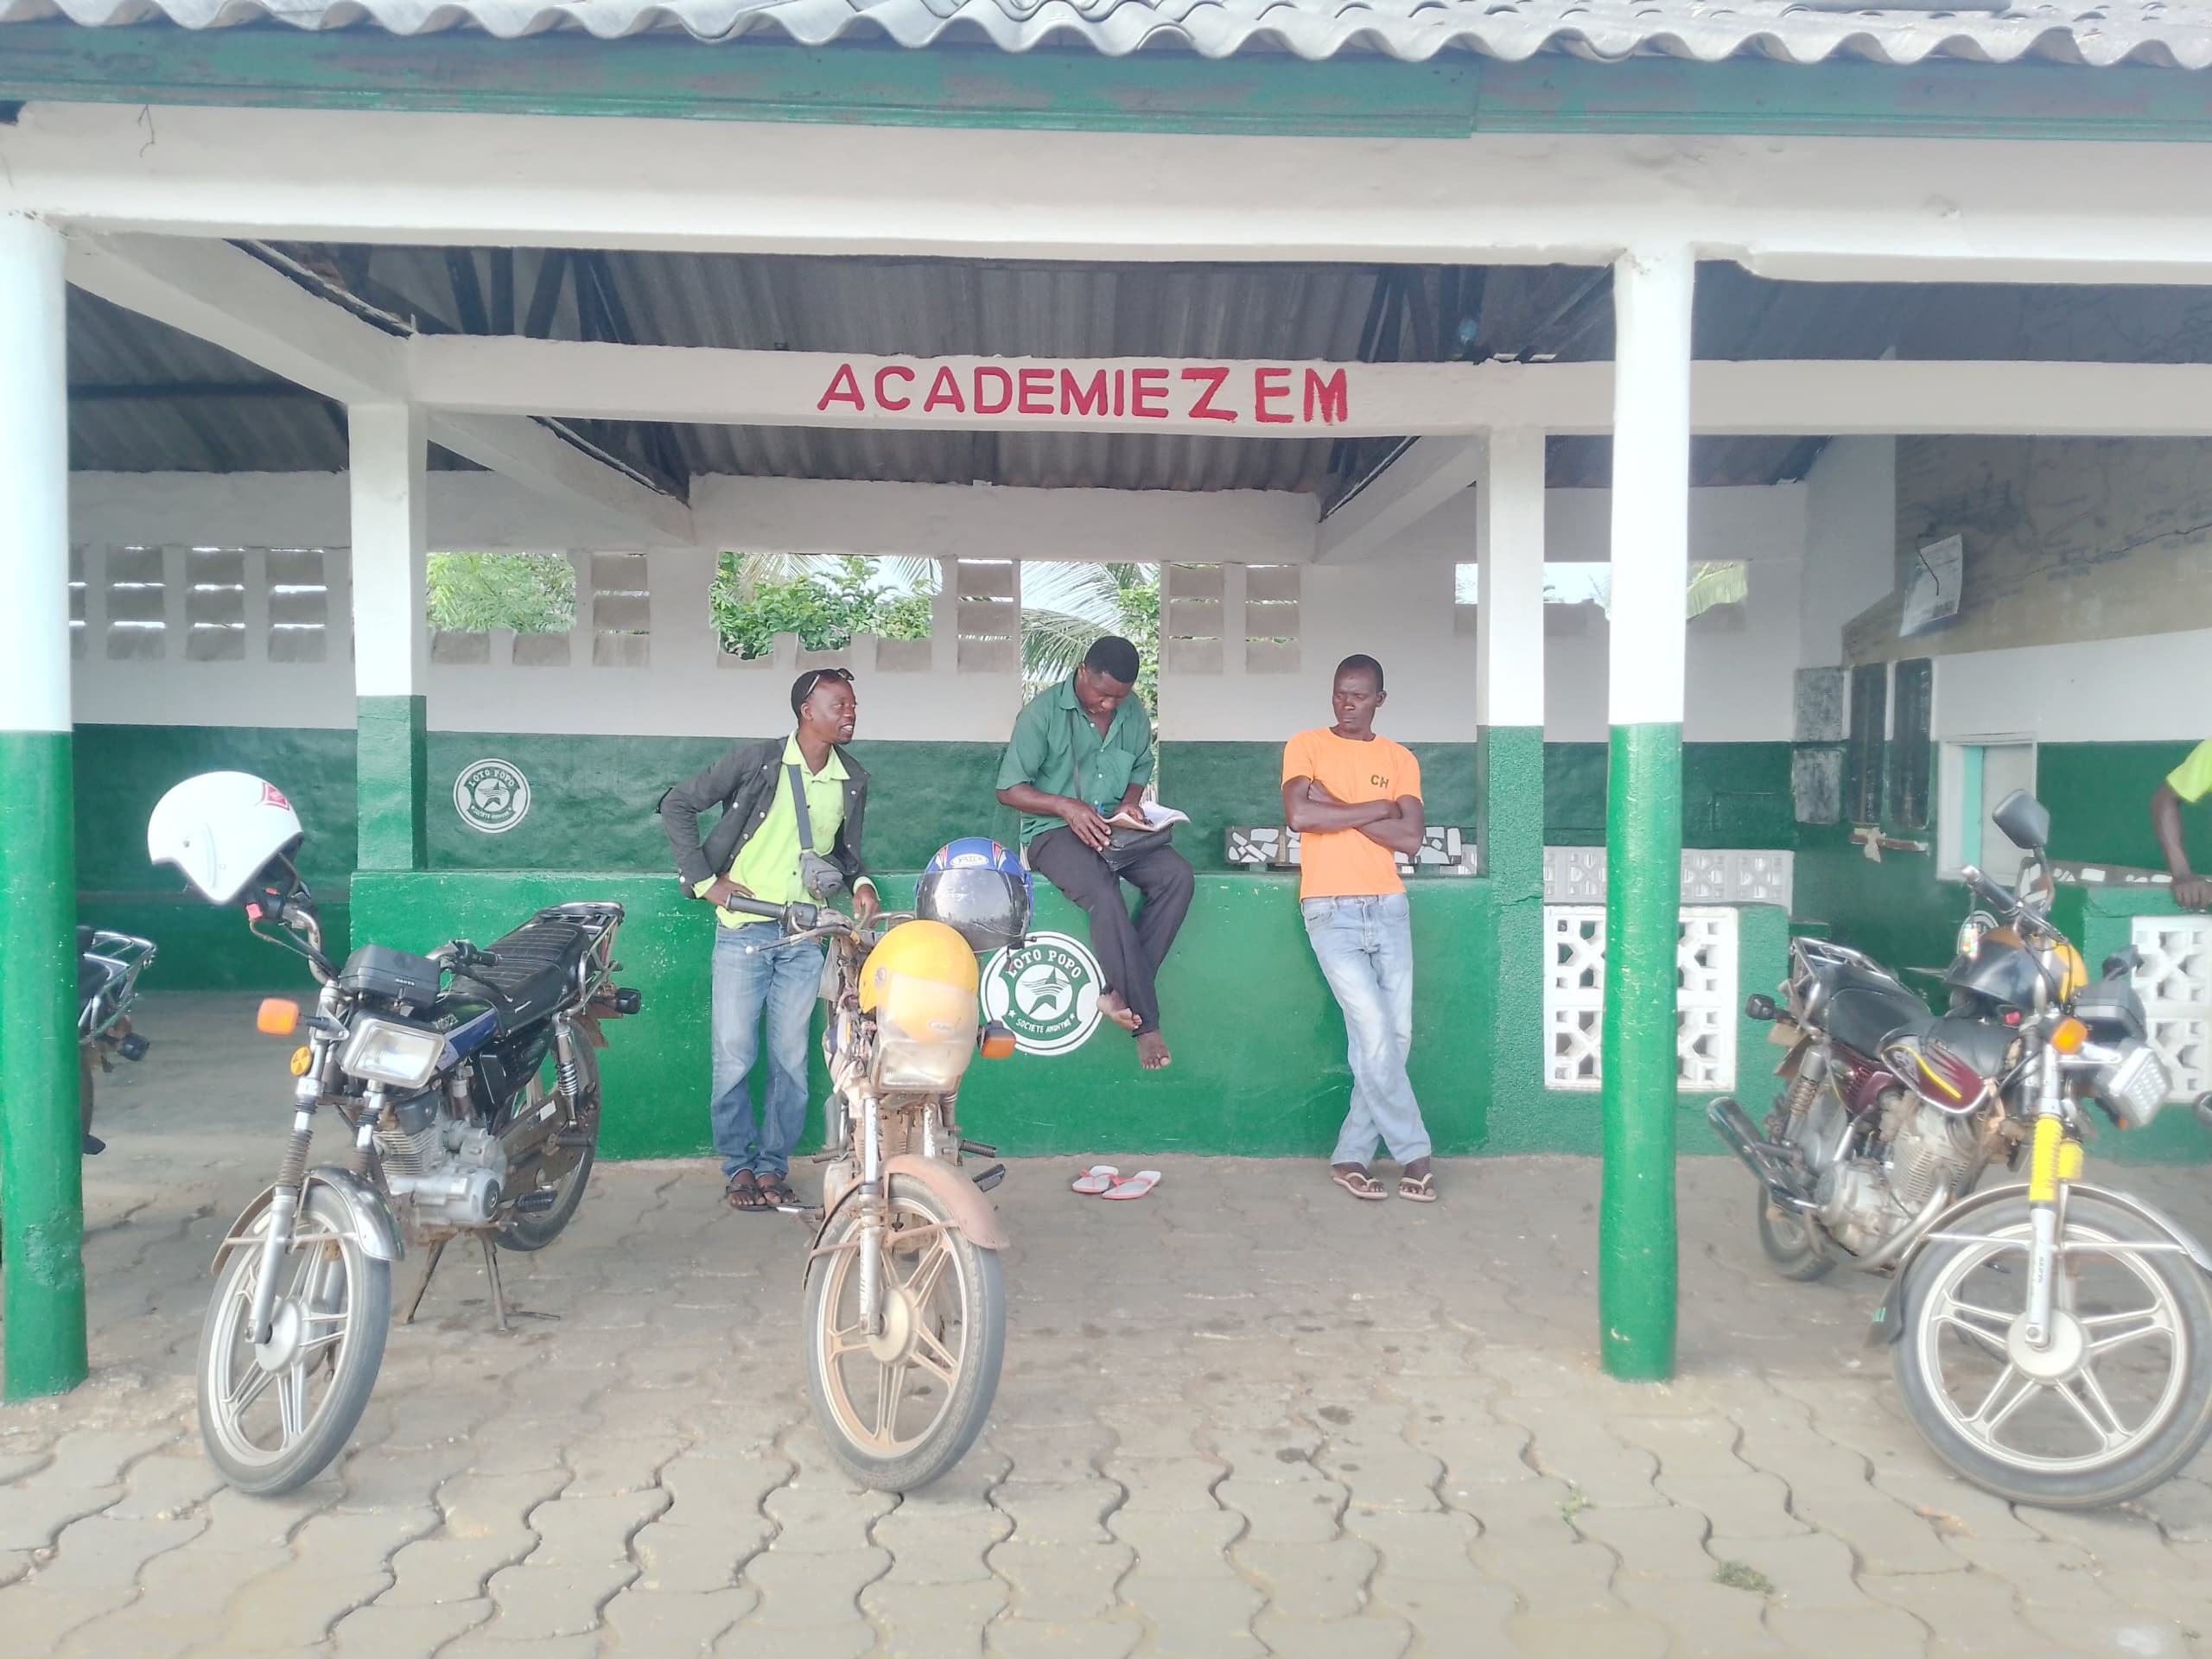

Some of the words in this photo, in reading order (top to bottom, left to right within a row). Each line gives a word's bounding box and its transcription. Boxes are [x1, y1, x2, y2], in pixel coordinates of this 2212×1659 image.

[817, 363, 1170, 418] ACADEMIE
[1180, 366, 1349, 424] ZEM
[468, 769, 491, 787] LOTO
[494, 769, 515, 787] POPO
[1370, 774, 1389, 789] CH
[1006, 949, 1042, 978] LOTO
[1048, 950, 1082, 978] POPO
